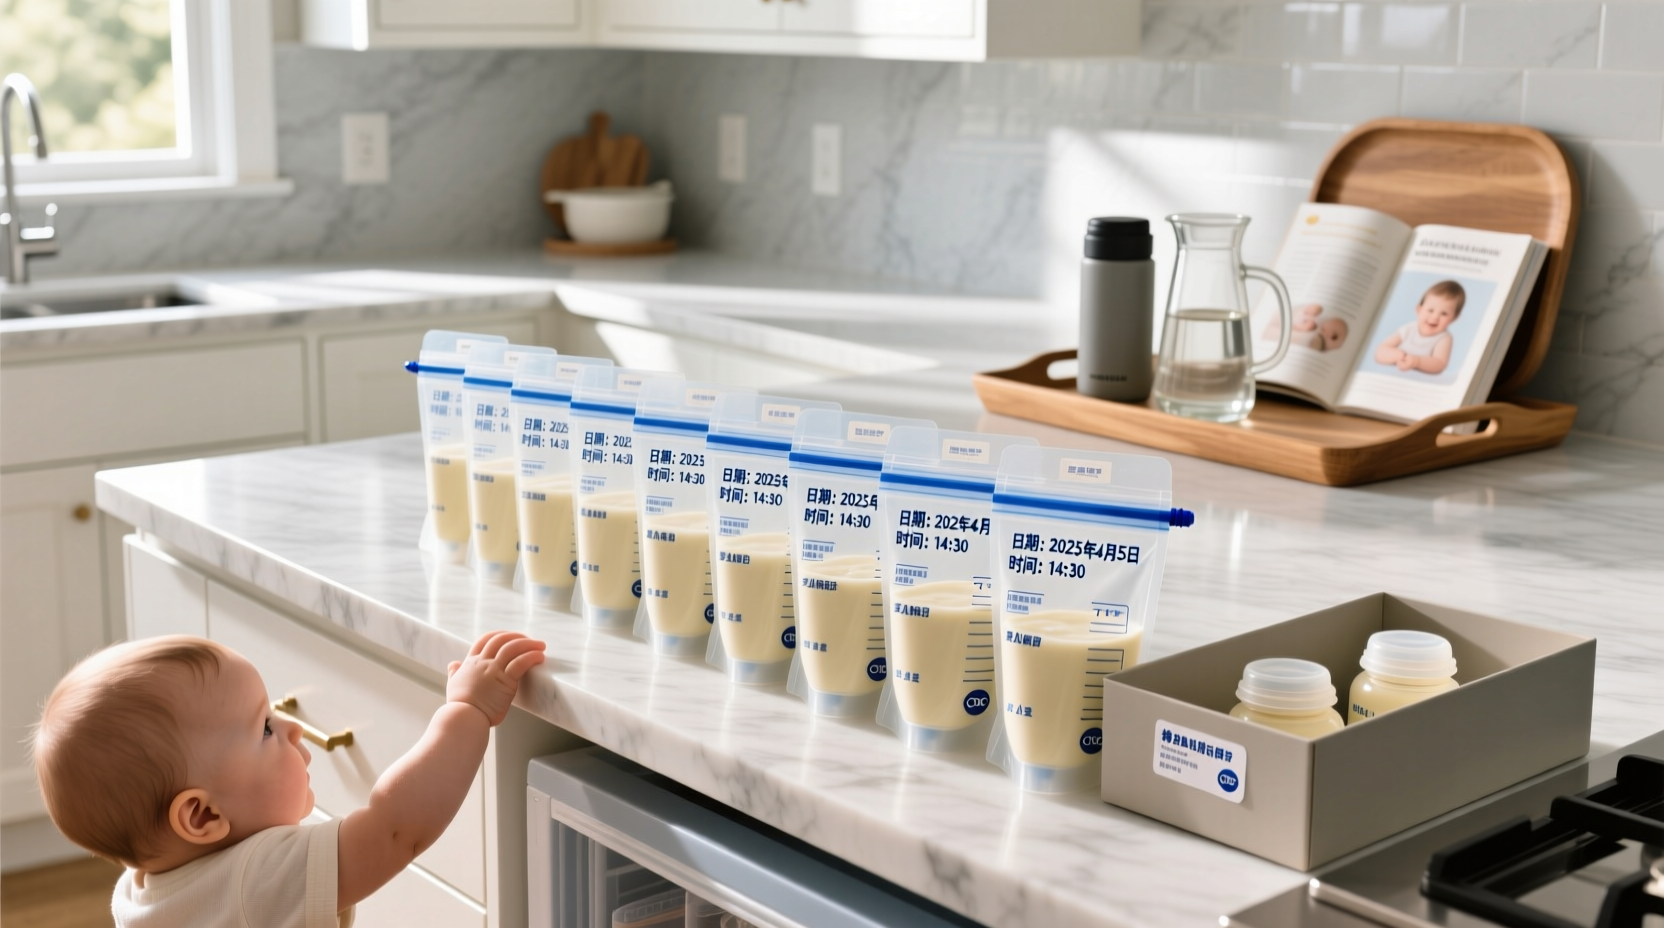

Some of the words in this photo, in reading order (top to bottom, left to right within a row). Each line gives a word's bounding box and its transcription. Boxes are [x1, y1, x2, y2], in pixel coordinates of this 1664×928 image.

[804, 508, 834, 526] 时间:
[900, 510, 930, 528] 日期:
[896, 530, 928, 549] 时间:
[935, 536, 969, 553] 14:30
[1013, 533, 1044, 552] 日期:
[1049, 538, 1140, 564] 2025年4月5日
[1009, 554, 1042, 575] 时间:
[1049, 561, 1086, 578] 14:30
